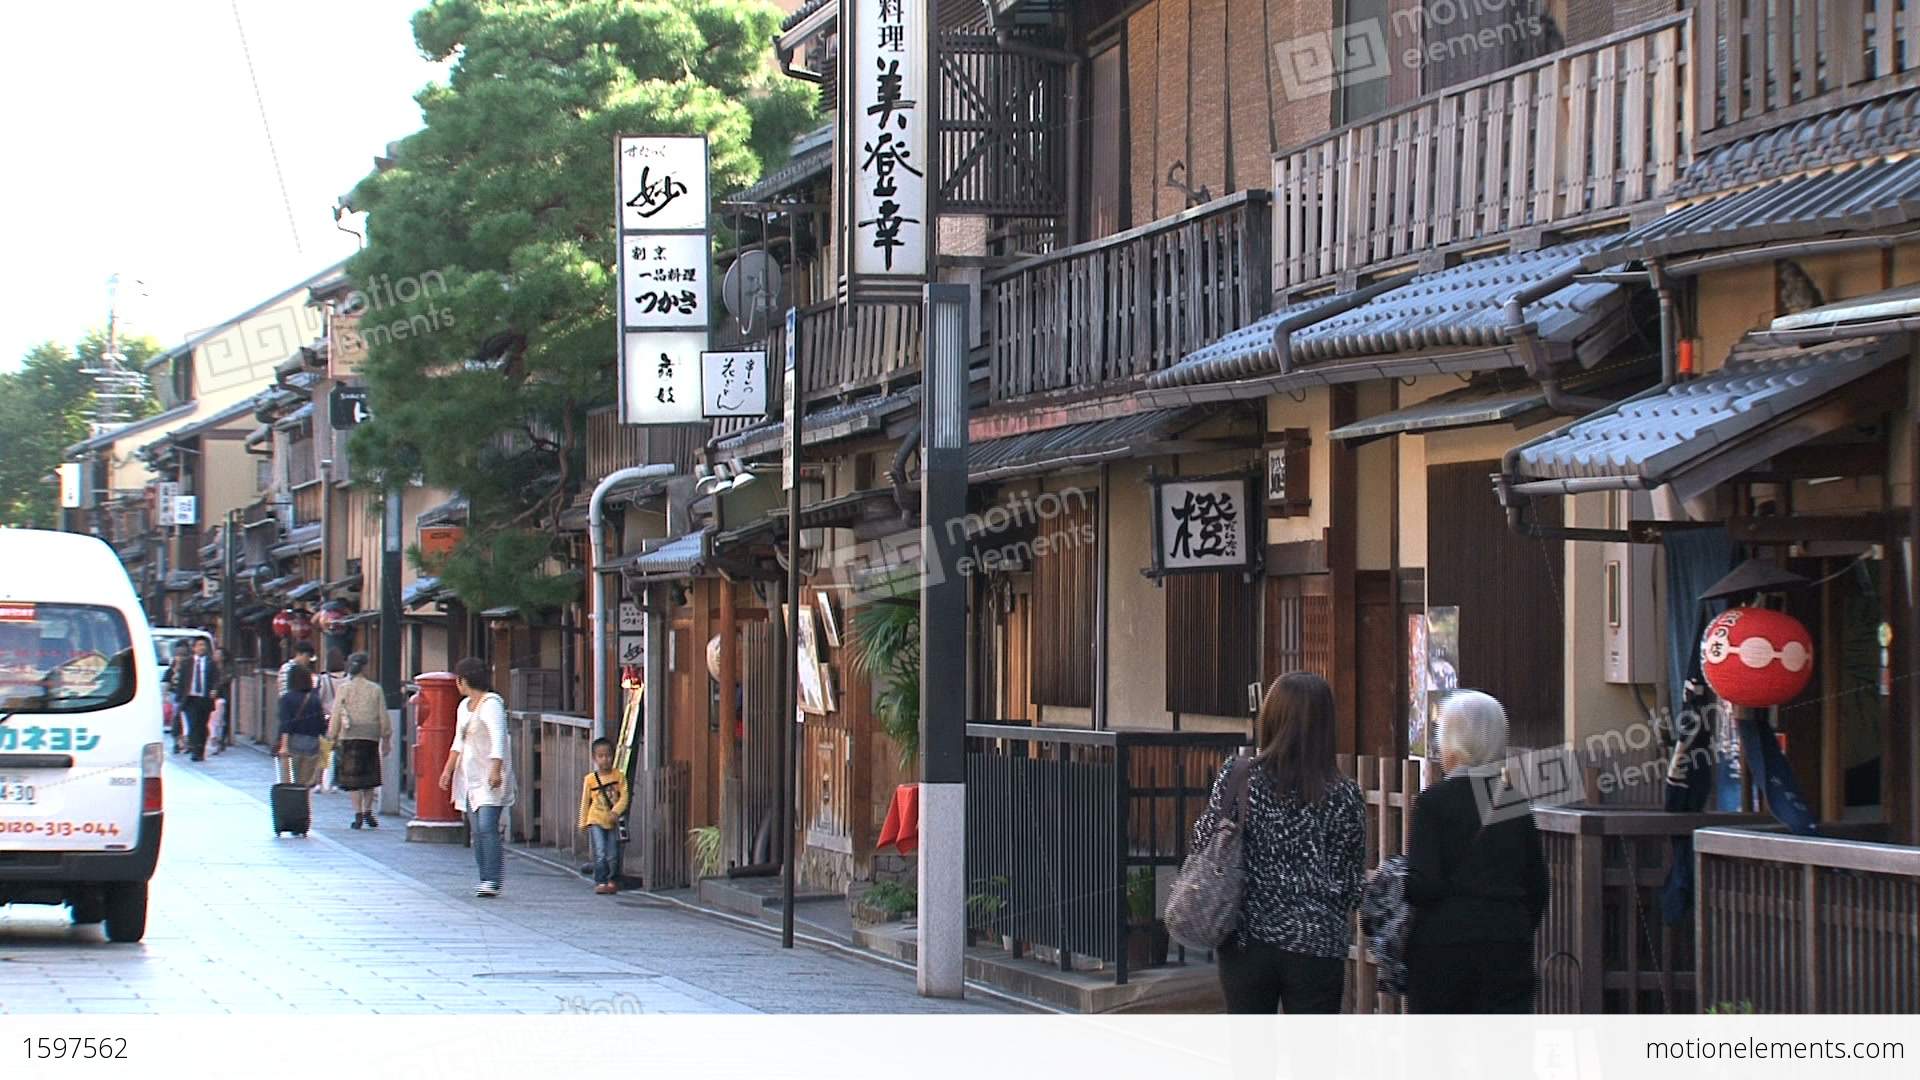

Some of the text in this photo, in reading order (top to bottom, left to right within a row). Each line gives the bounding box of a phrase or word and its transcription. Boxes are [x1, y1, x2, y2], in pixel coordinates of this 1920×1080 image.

[877, 0, 905, 53] 料理
[857, 56, 924, 272] 美登幸
[626, 165, 688, 219] 妙
[632, 245, 668, 261] 割烹
[639, 267, 697, 283] 一品料理
[635, 289, 698, 315] つかさ
[1169, 489, 1238, 560] 橙
[0, 725, 102, 752] カネヨシ
